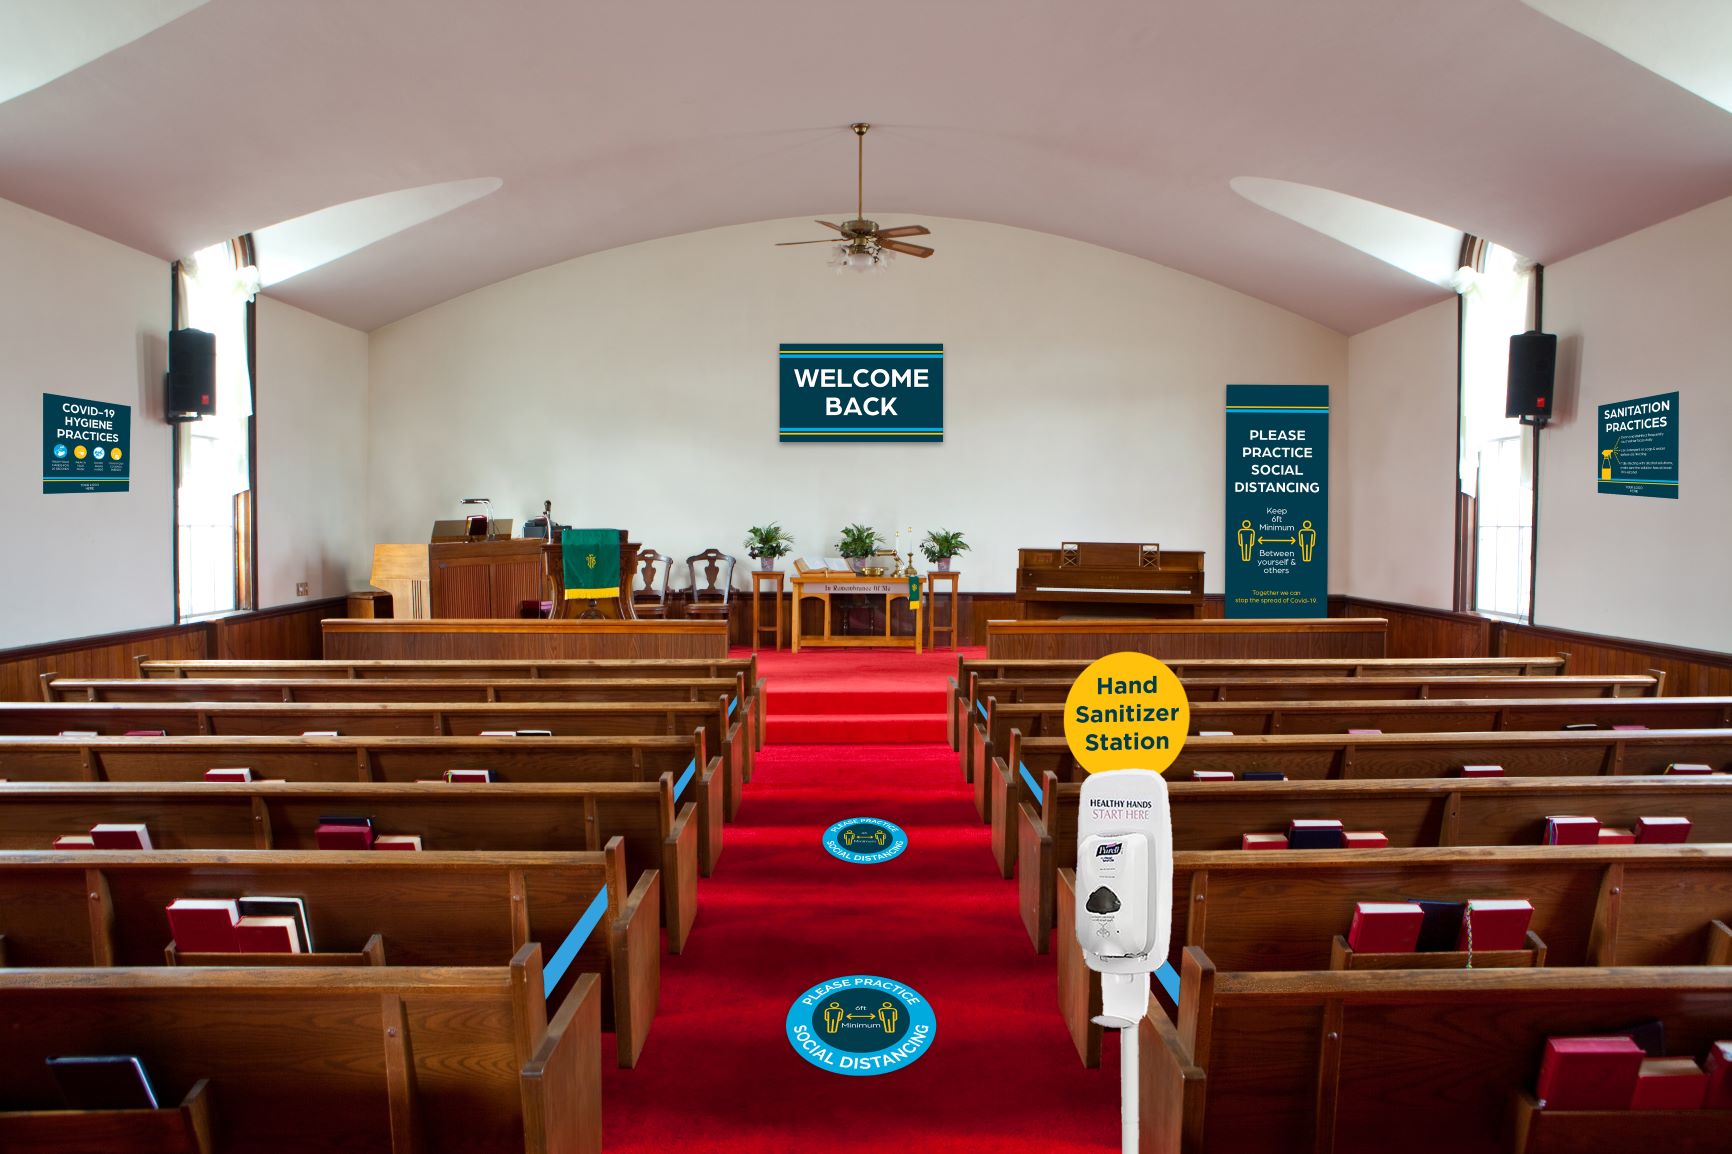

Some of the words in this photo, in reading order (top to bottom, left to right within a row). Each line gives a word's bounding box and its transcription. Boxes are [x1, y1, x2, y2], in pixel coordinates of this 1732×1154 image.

[794, 368, 929, 388] WELCOME
[62, 402, 116, 418] COVID-19
[825, 396, 898, 416] BACK
[1604, 400, 1670, 420] SANITATION
[64, 416, 113, 430] HYGIENE
[1606, 416, 1668, 432] PRACTICES
[56, 428, 119, 442] PRACTICES
[1249, 429, 1306, 441] PLEASE
[1242, 446, 1313, 458] PRACTICE
[1251, 464, 1304, 476] SOCIAL
[1234, 482, 1320, 494] DISTANCING
[1266, 507, 1288, 515] Keep
[1257, 558, 1289, 566] yourself
[1097, 676, 1158, 695] Hand
[1076, 704, 1180, 724] Sanitizer
[1085, 732, 1170, 752] Station
[1090, 799, 1125, 808] HEALTHY
[1126, 800, 1152, 809] HANDS
[1092, 809, 1124, 820] START
[1126, 809, 1150, 820] HERE
[830, 818, 858, 832] PLEASE
[860, 818, 899, 832] PRACTICE
[826, 840, 851, 860] SOCIAL
[853, 840, 904, 862] DISTANCING
[802, 978, 852, 1006] PLEASE
[854, 978, 920, 1006] PRACTICE
[794, 1024, 834, 1065] SOCIAL
[839, 1024, 929, 1070] DISTANCING
